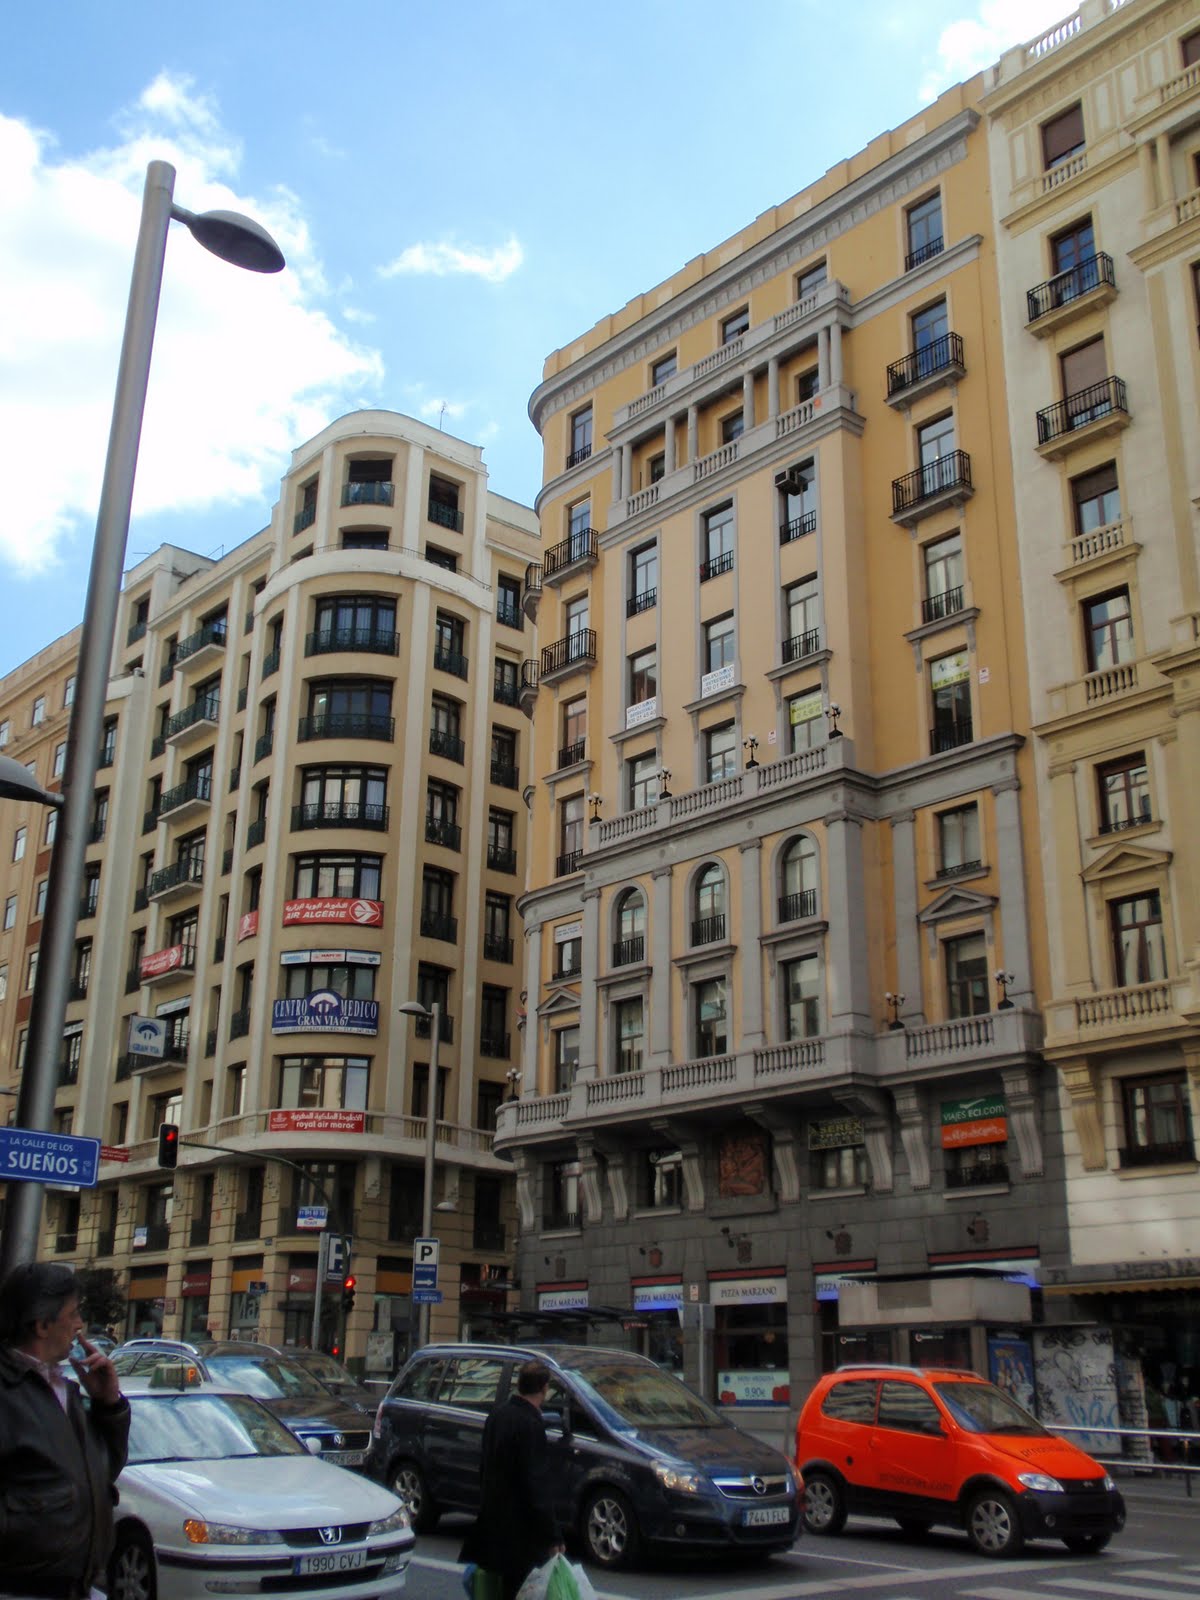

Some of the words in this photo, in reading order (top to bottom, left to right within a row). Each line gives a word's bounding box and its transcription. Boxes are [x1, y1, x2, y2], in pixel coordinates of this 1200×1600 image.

[285, 911, 300, 920] AIR
[275, 999, 307, 1018] CENTRO
[340, 999, 377, 1019] MEDICO
[297, 1015, 322, 1027] GRAN
[324, 1015, 339, 1026] VIA
[339, 1016, 349, 1026] 67
[943, 1111, 966, 1121] VIAJES
[968, 1104, 1005, 1117] ECI.com
[296, 1121, 316, 1129] royal
[10, 1137, 20, 1145] LA
[22, 1138, 45, 1149] CALLE
[47, 1142, 57, 1151] DE
[59, 1143, 74, 1152] LOS
[8, 1150, 78, 1175] SUEÑOS
[420, 1246, 433, 1261] P
[721, 1288, 740, 1298] PIZZA
[741, 1286, 777, 1296] MARZANO
[817, 1282, 837, 1292] PIZZA
[542, 1298, 557, 1308] PIZZA
[559, 1297, 587, 1306] MARZANO
[635, 1295, 651, 1303] PIZZA
[749, 1511, 770, 1522] 7441
[772, 1510, 787, 1521] FLC
[307, 1556, 335, 1572] 1990
[340, 1553, 362, 1569] CVJ
